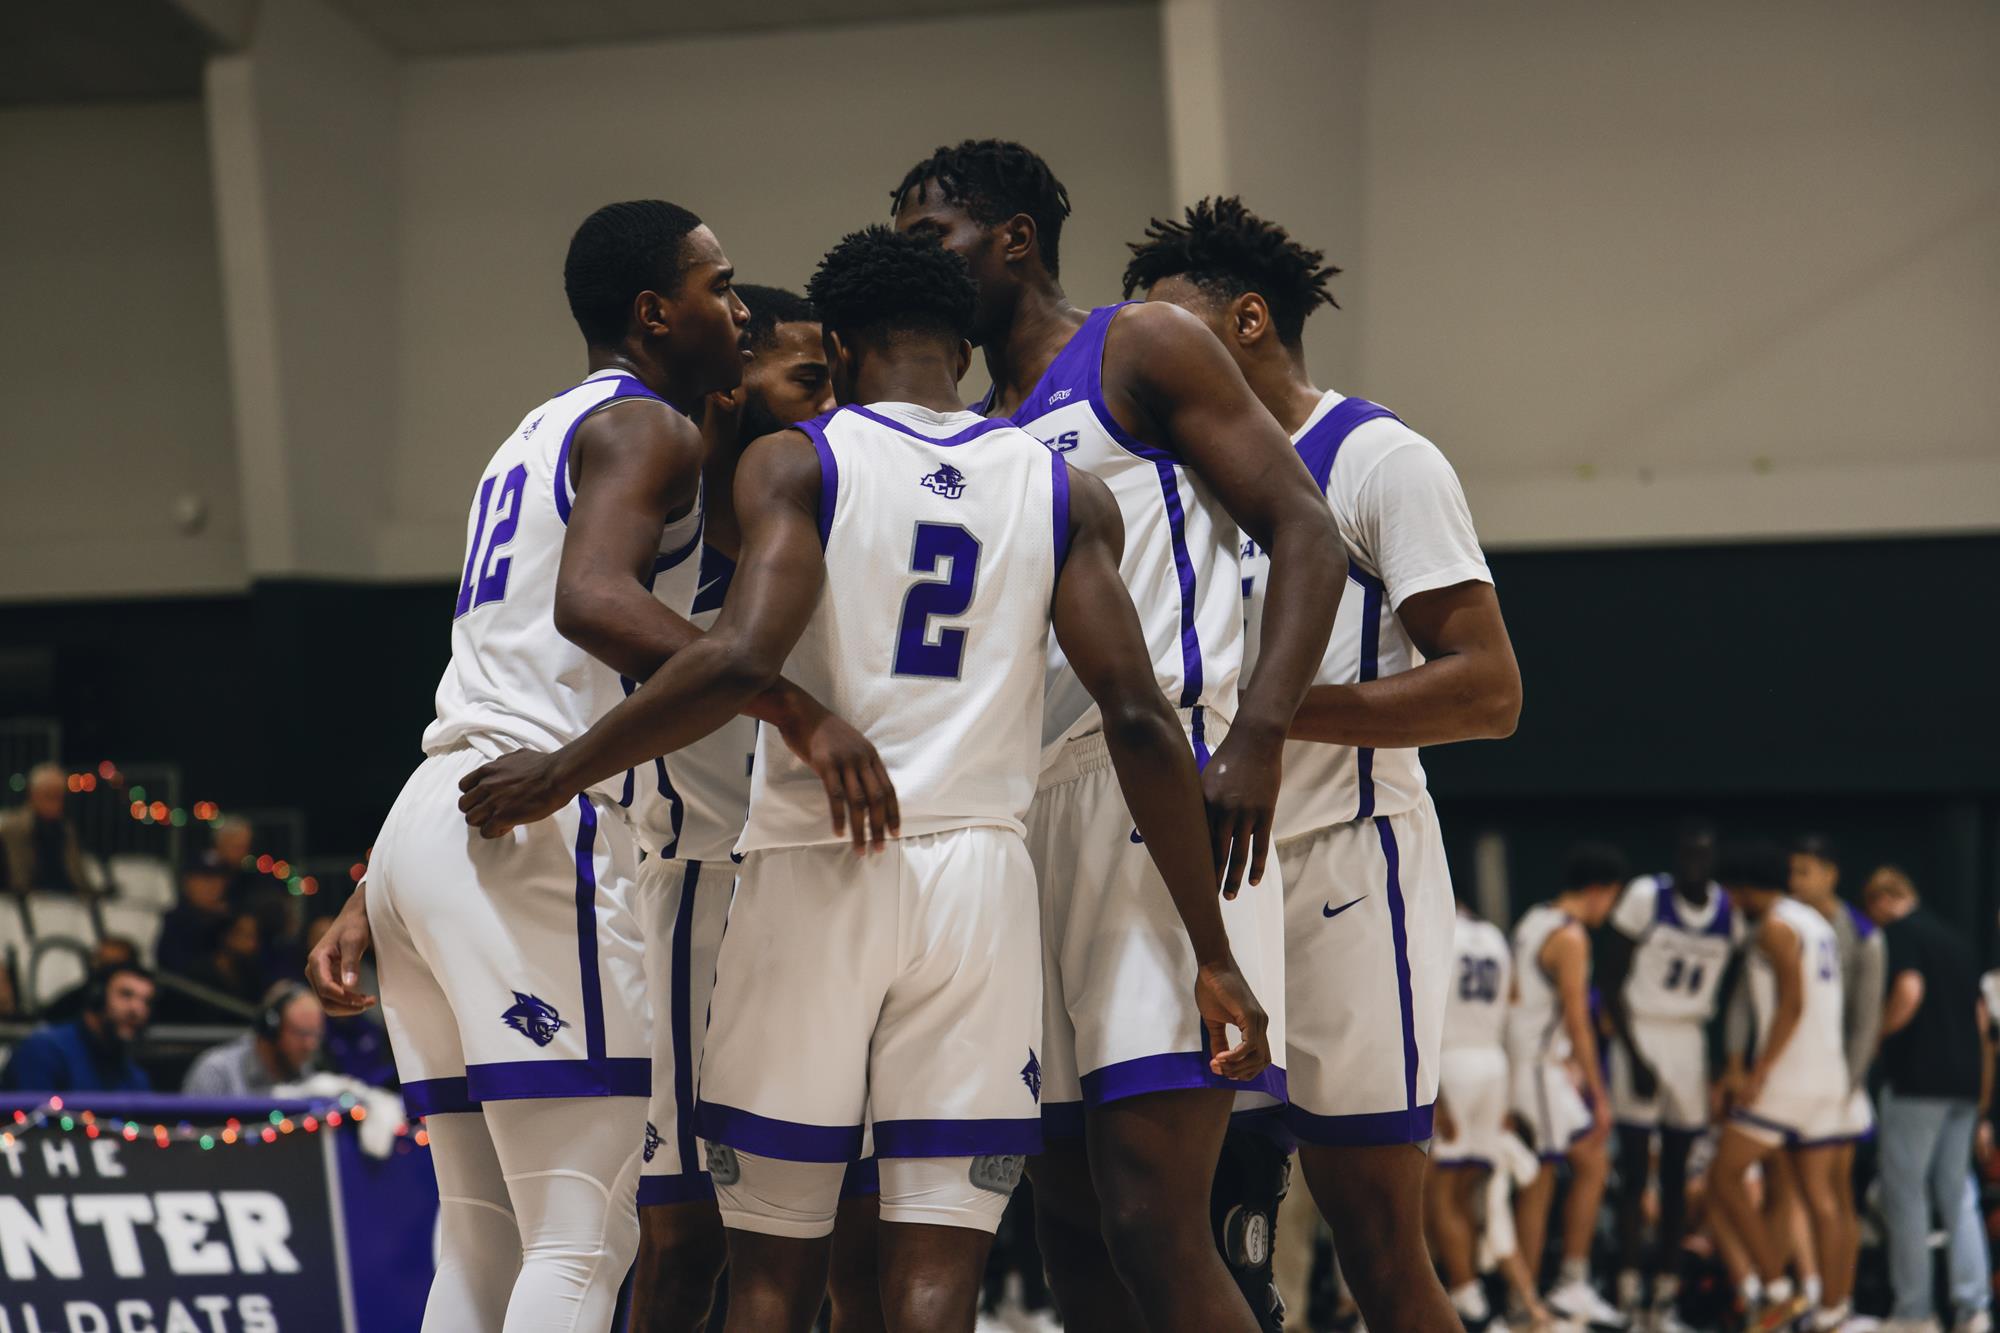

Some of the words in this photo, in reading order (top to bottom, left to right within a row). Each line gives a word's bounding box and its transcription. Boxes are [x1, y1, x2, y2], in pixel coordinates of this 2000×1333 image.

[920, 473, 967, 500] ACU
[453, 462, 528, 623] 12
[891, 520, 983, 682] 2
[0, 1138, 127, 1179] THE
[0, 1190, 302, 1281] NTER
